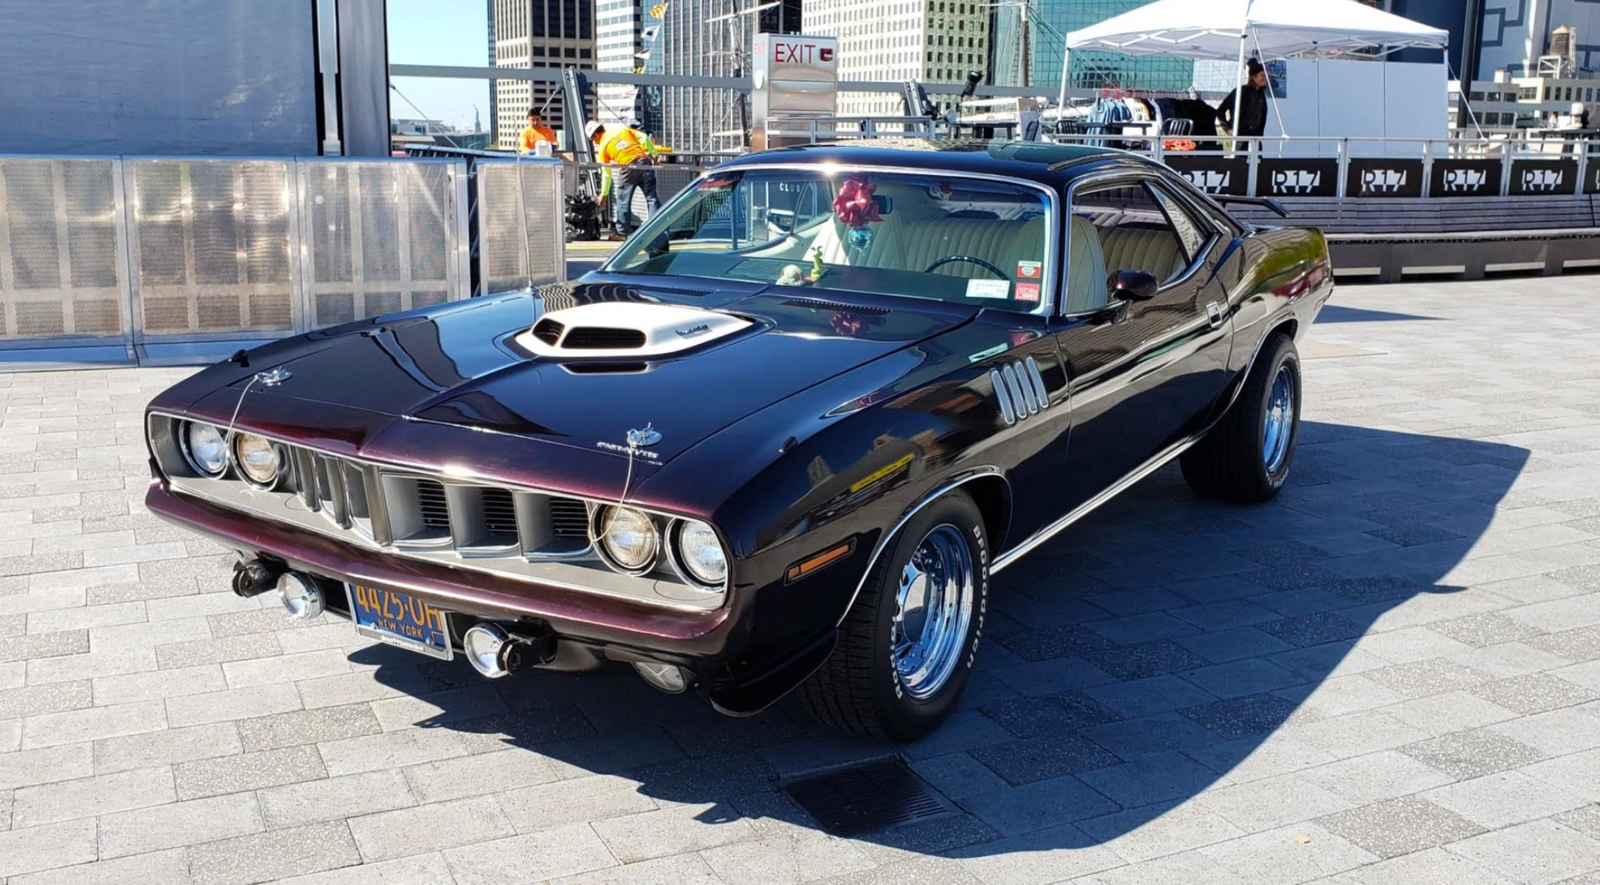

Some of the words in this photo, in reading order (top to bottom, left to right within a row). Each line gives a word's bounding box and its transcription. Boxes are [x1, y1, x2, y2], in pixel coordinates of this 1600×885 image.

[775, 43, 816, 63] EXIT
[1272, 170, 1320, 193] R17
[1361, 169, 1407, 192] R17
[1443, 169, 1487, 191] R17
[1522, 169, 1563, 191] R17
[378, 619, 397, 631] NEW
[400, 624, 423, 639] YORK
